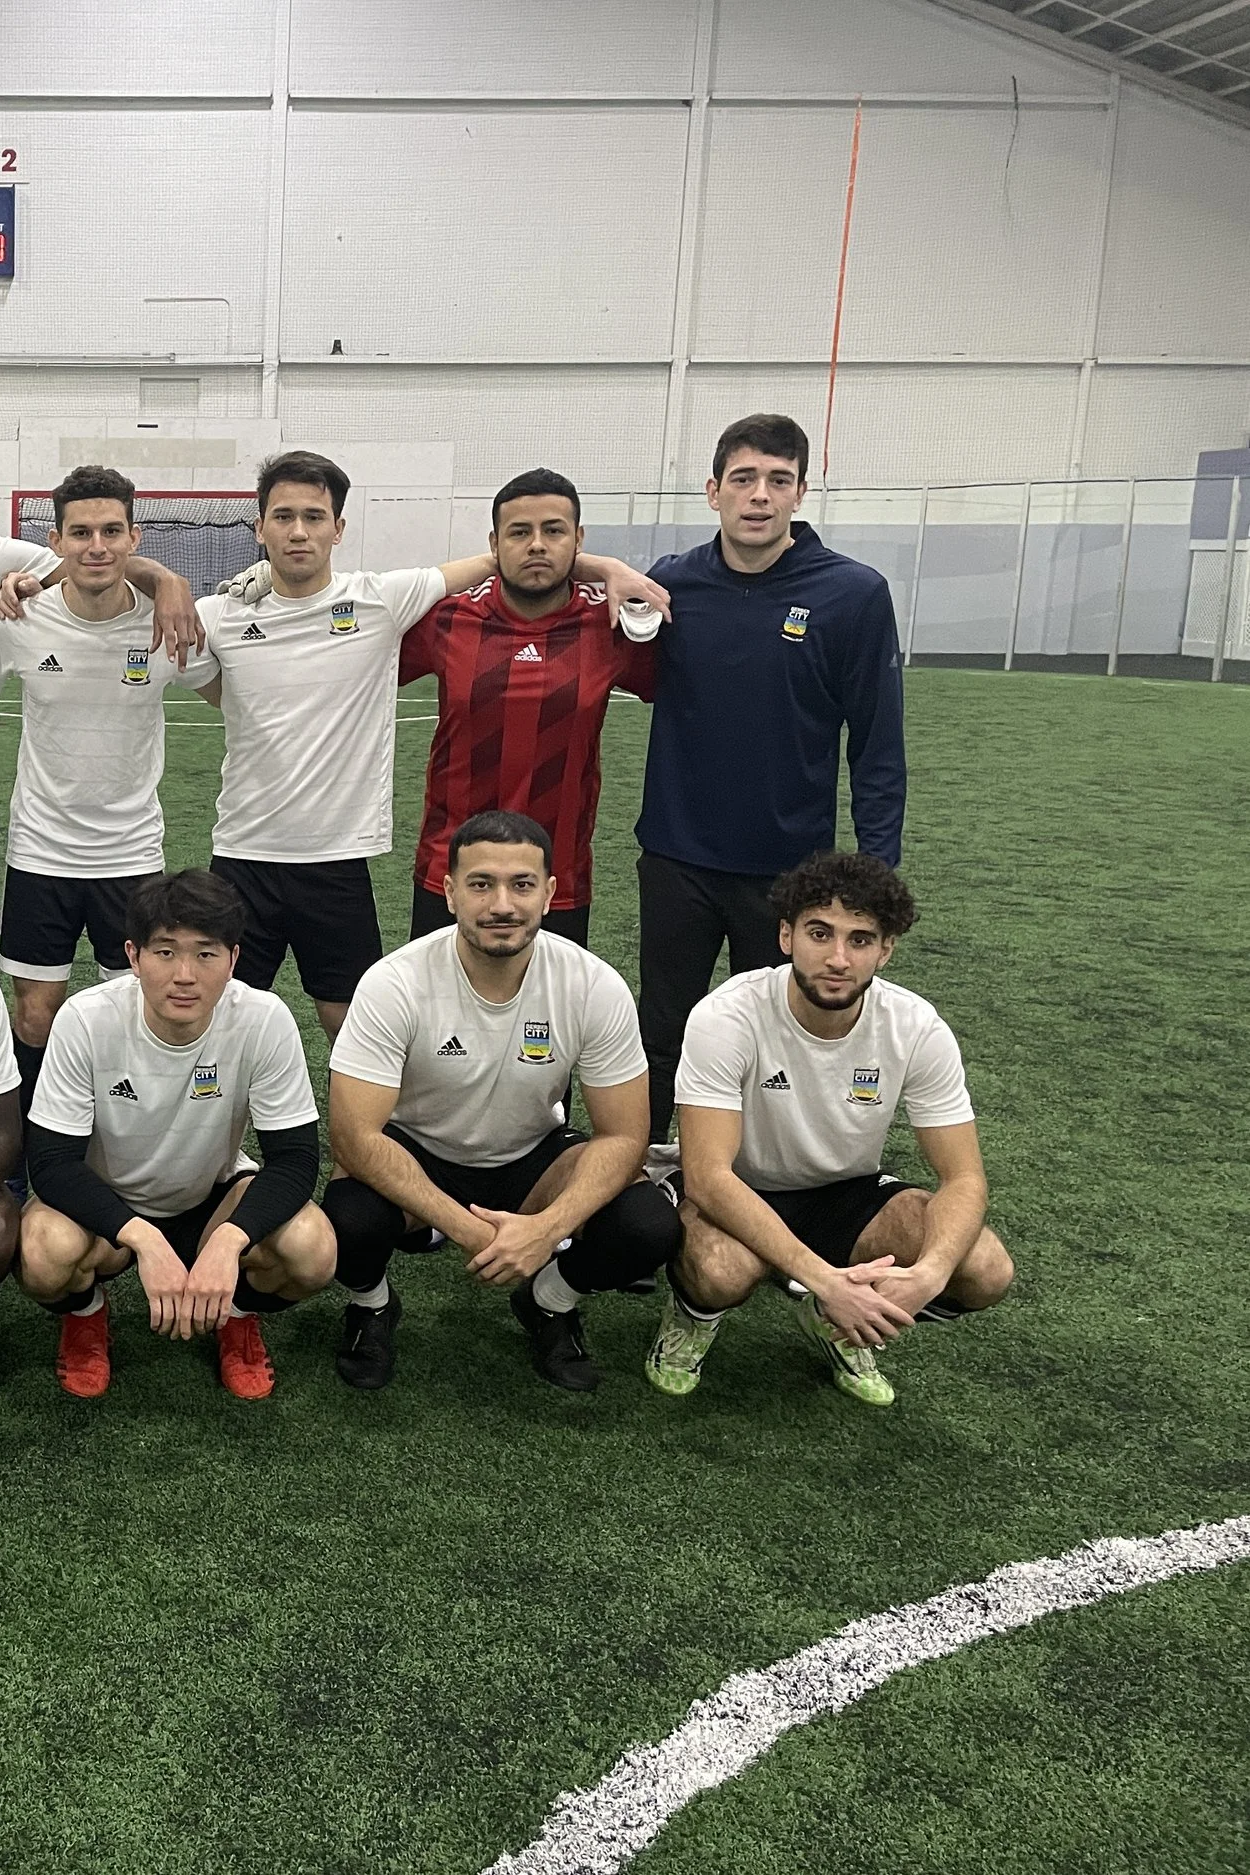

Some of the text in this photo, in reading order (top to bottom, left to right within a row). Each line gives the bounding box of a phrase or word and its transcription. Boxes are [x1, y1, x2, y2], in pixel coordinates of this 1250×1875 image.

[332, 605, 352, 614] CITY
[788, 611, 809, 621] CITY
[128, 655, 148, 663] CITY
[514, 654, 543, 662] adidas
[525, 1029, 548, 1038] CITY
[195, 1071, 217, 1079] CITY
[854, 1074, 877, 1082] CITY
[760, 1082, 791, 1090] adidas
